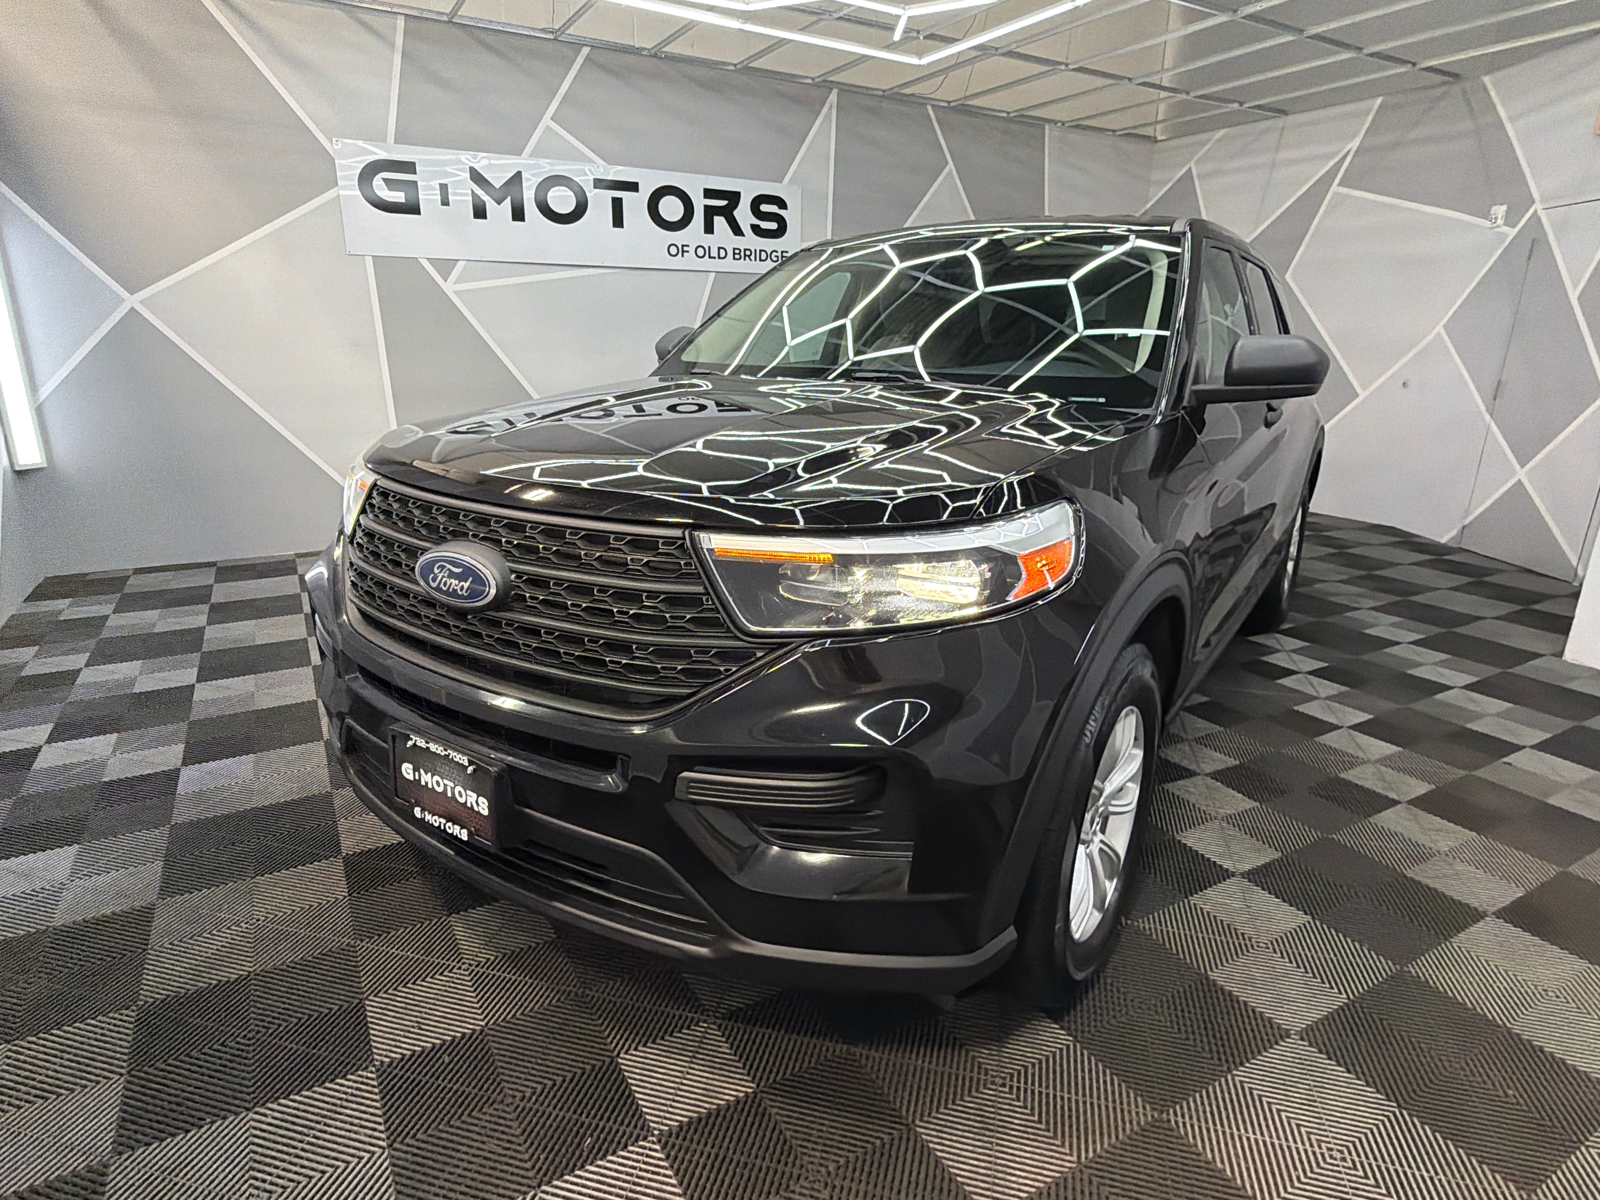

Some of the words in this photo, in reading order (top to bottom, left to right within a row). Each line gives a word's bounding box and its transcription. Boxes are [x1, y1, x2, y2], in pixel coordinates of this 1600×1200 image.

[667, 243, 690, 258] OF
[694, 244, 728, 260] OLD
[732, 247, 789, 263] BRIDGE
[429, 562, 473, 596] Ford
